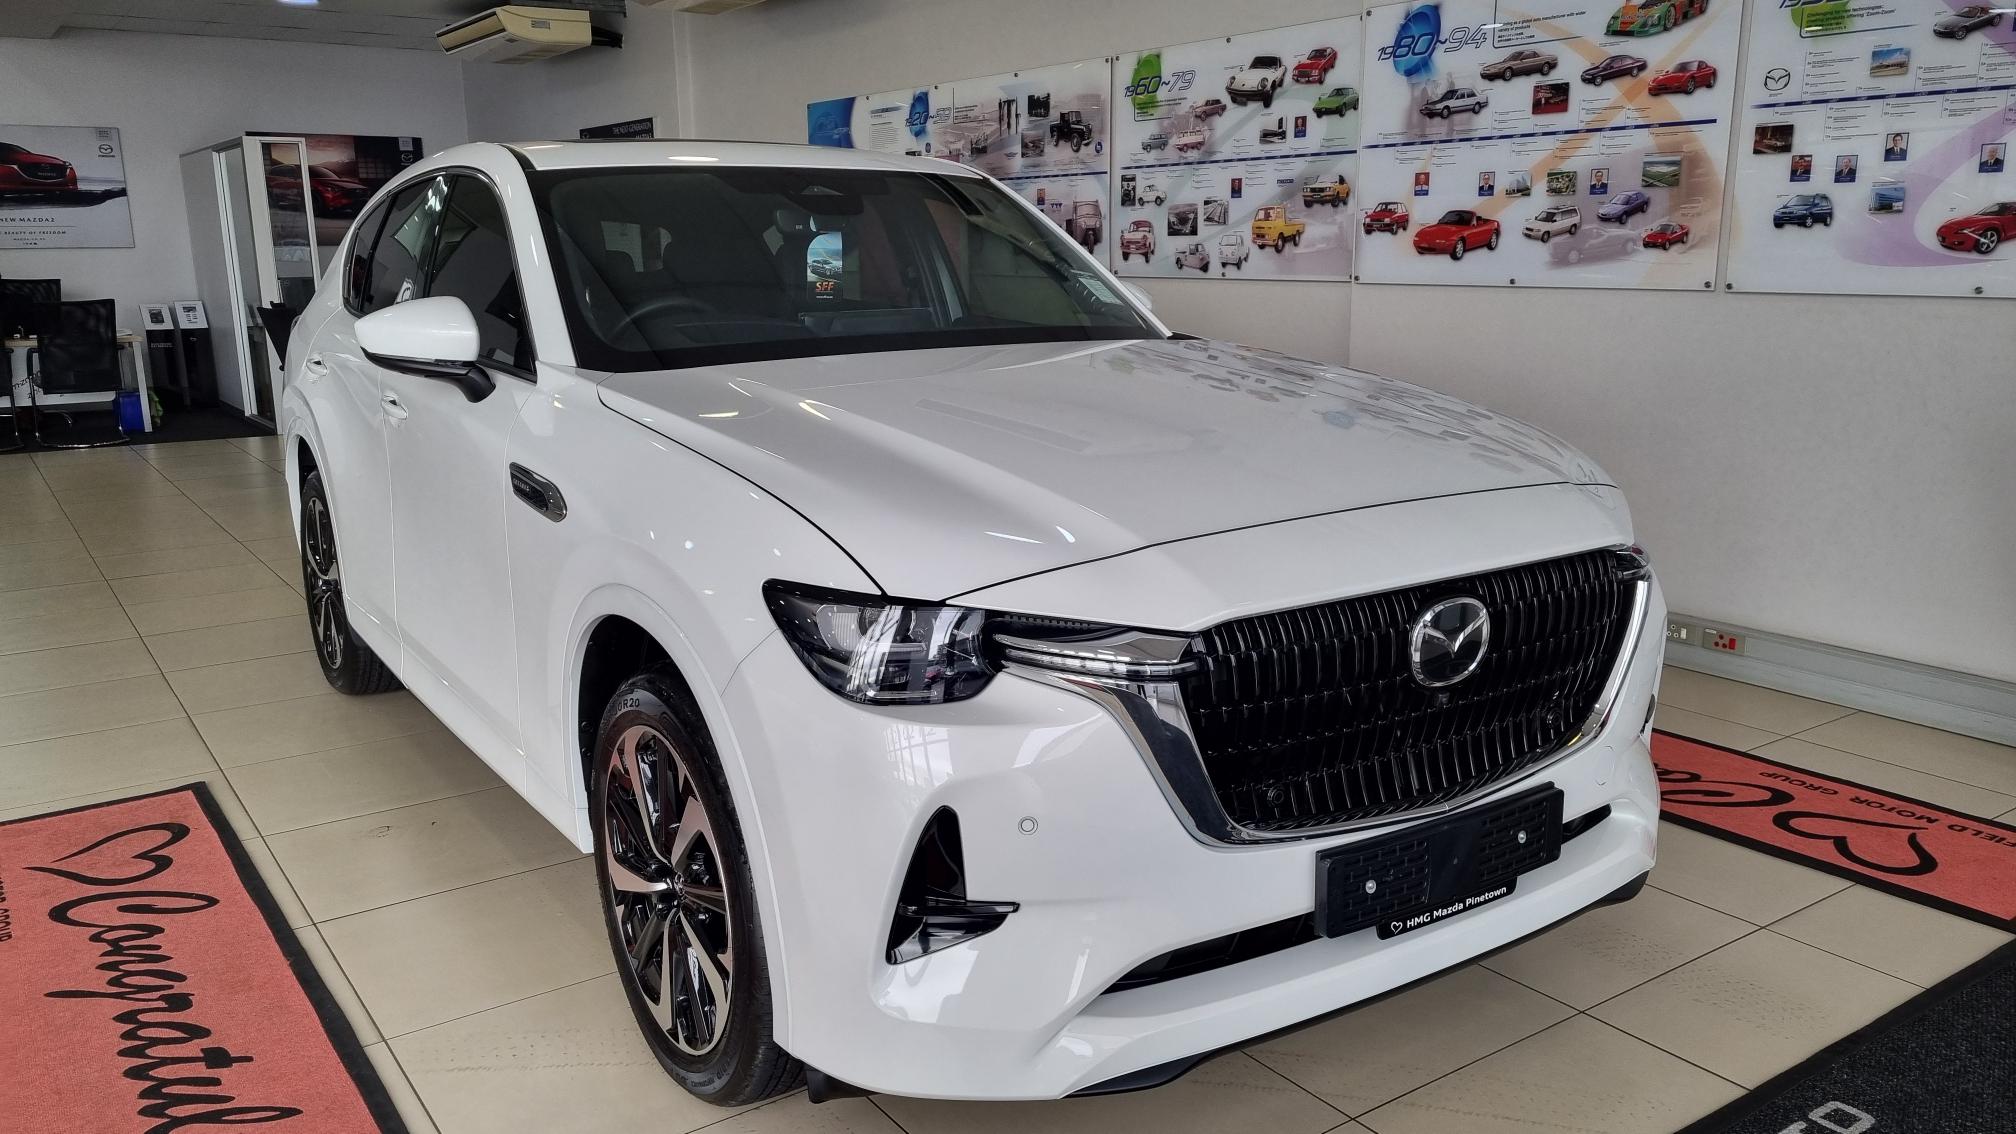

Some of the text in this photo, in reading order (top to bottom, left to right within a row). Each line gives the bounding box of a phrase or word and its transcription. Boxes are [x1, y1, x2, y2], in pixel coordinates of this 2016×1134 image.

[1759, 771, 1839, 796] GROUP
[1849, 795, 1940, 824] MOTOR
[1406, 886, 1507, 929] HMG Mazda Pinetown
